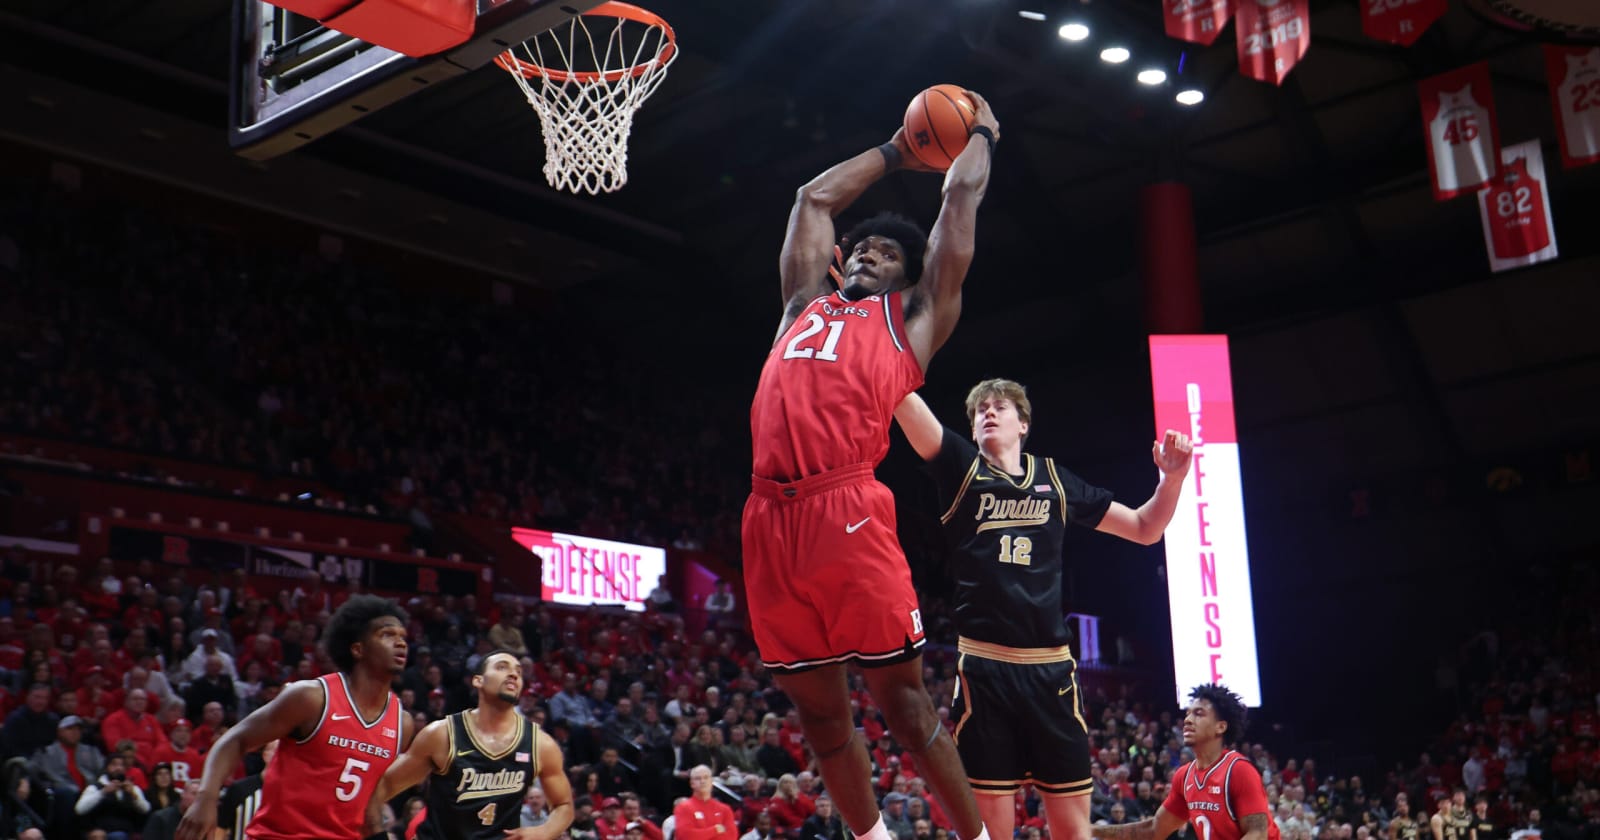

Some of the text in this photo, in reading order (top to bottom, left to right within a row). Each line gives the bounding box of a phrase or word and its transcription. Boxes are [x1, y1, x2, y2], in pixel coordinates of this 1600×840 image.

[1245, 16, 1302, 54] 2019
[1443, 114, 1479, 145] 45
[1497, 186, 1532, 217] 82
[783, 311, 845, 362] 21
[975, 493, 1051, 523] Purdue
[999, 534, 1032, 566] 12
[1186, 383, 1222, 687] DEFENSE
[551, 543, 642, 603] DEFENSE
[328, 735, 391, 759] RUTGERS
[171, 761, 192, 783] R
[335, 757, 370, 802] 5
[456, 767, 525, 794] Purdue
[477, 802, 497, 826] 4
